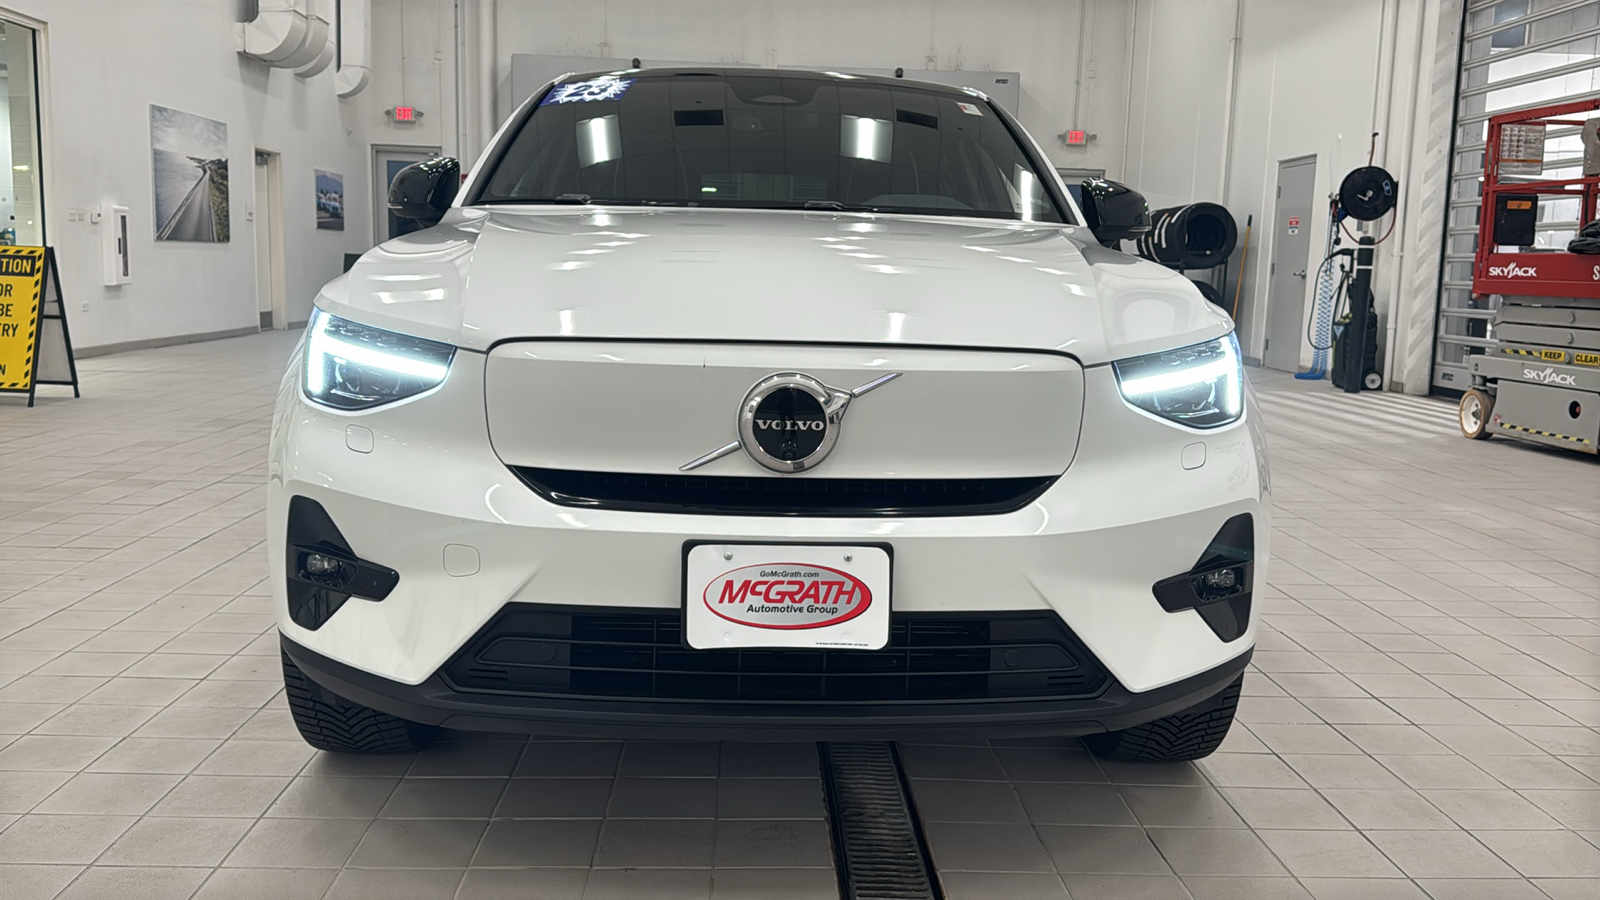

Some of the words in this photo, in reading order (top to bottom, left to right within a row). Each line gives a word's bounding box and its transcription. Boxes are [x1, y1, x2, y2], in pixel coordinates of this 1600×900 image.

[564, 83, 613, 97] 23
[1488, 262, 1537, 278] SKYJACK
[1543, 351, 1562, 359] KEEP
[1575, 354, 1599, 364] CLEAR
[1523, 367, 1576, 385] SKYJACK
[755, 420, 824, 430] VOLVO
[759, 570, 820, 578] GoMcGrath.com
[746, 604, 804, 613] Automotive
[806, 605, 838, 615] Group
